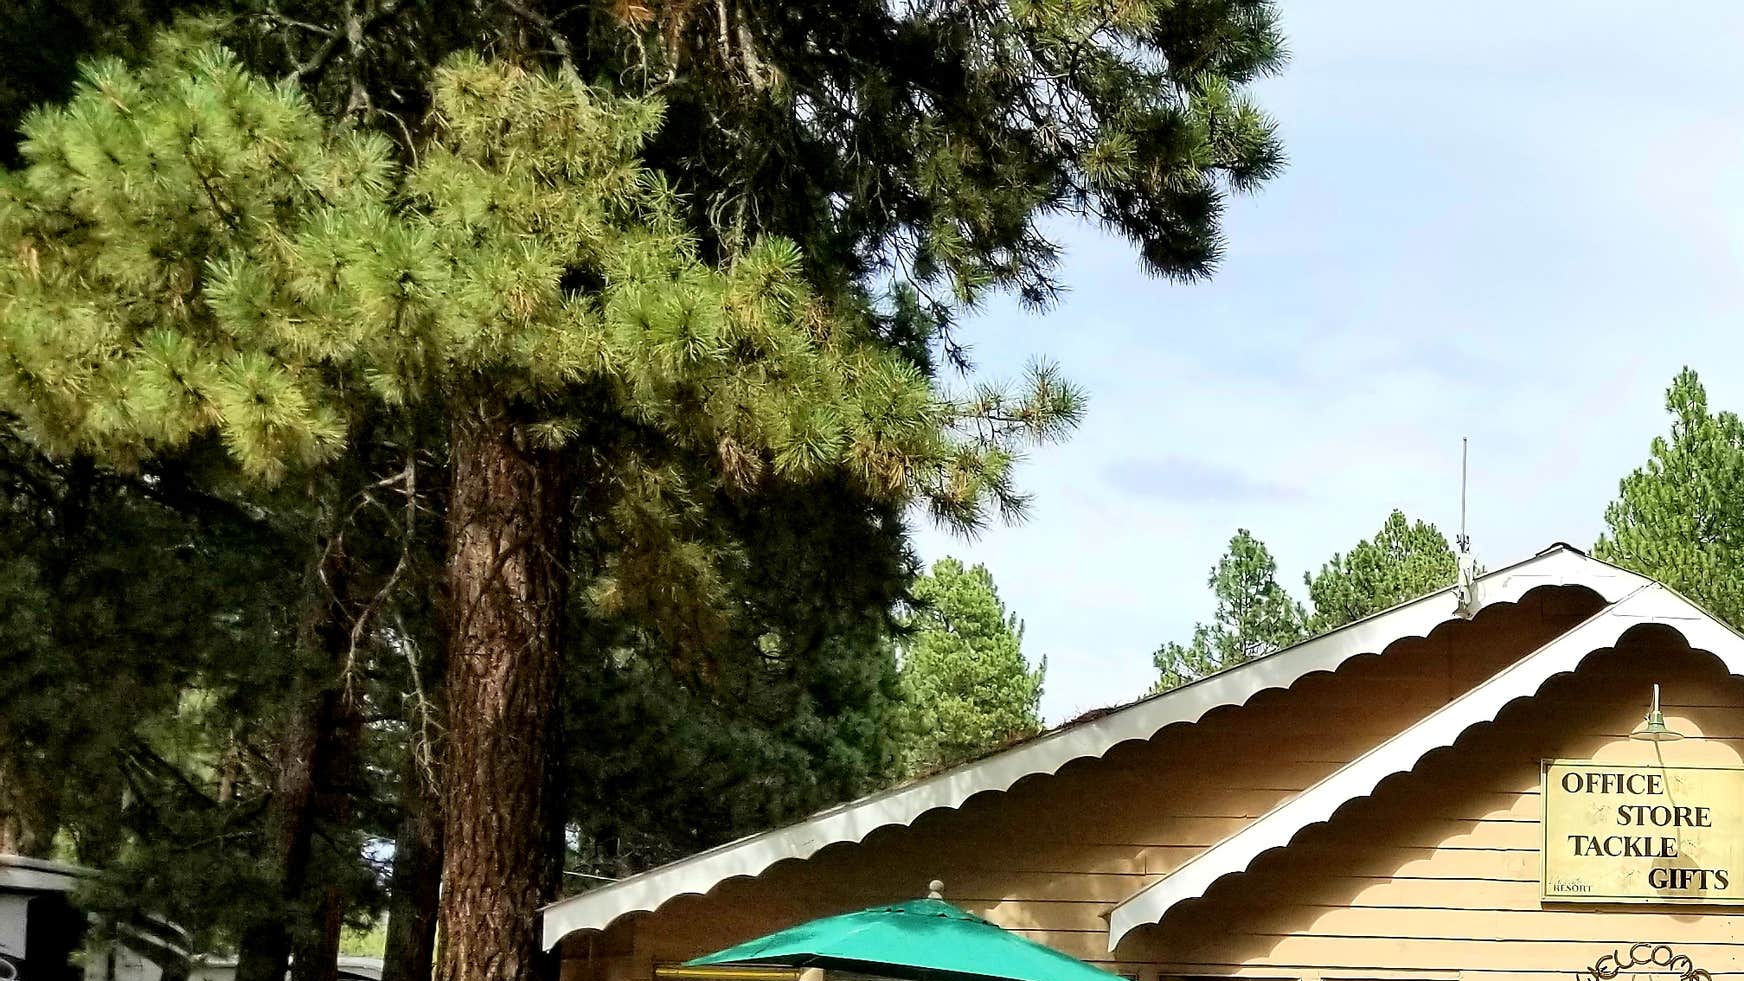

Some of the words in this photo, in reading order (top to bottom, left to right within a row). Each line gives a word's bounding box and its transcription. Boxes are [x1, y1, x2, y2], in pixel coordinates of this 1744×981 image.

[1561, 772, 1664, 795] OFFICE
[1617, 805, 1712, 827] STORE
[1567, 835, 1678, 858] TACKLE
[1553, 884, 1592, 893] RESORT
[1648, 868, 1729, 890] GIFTS
